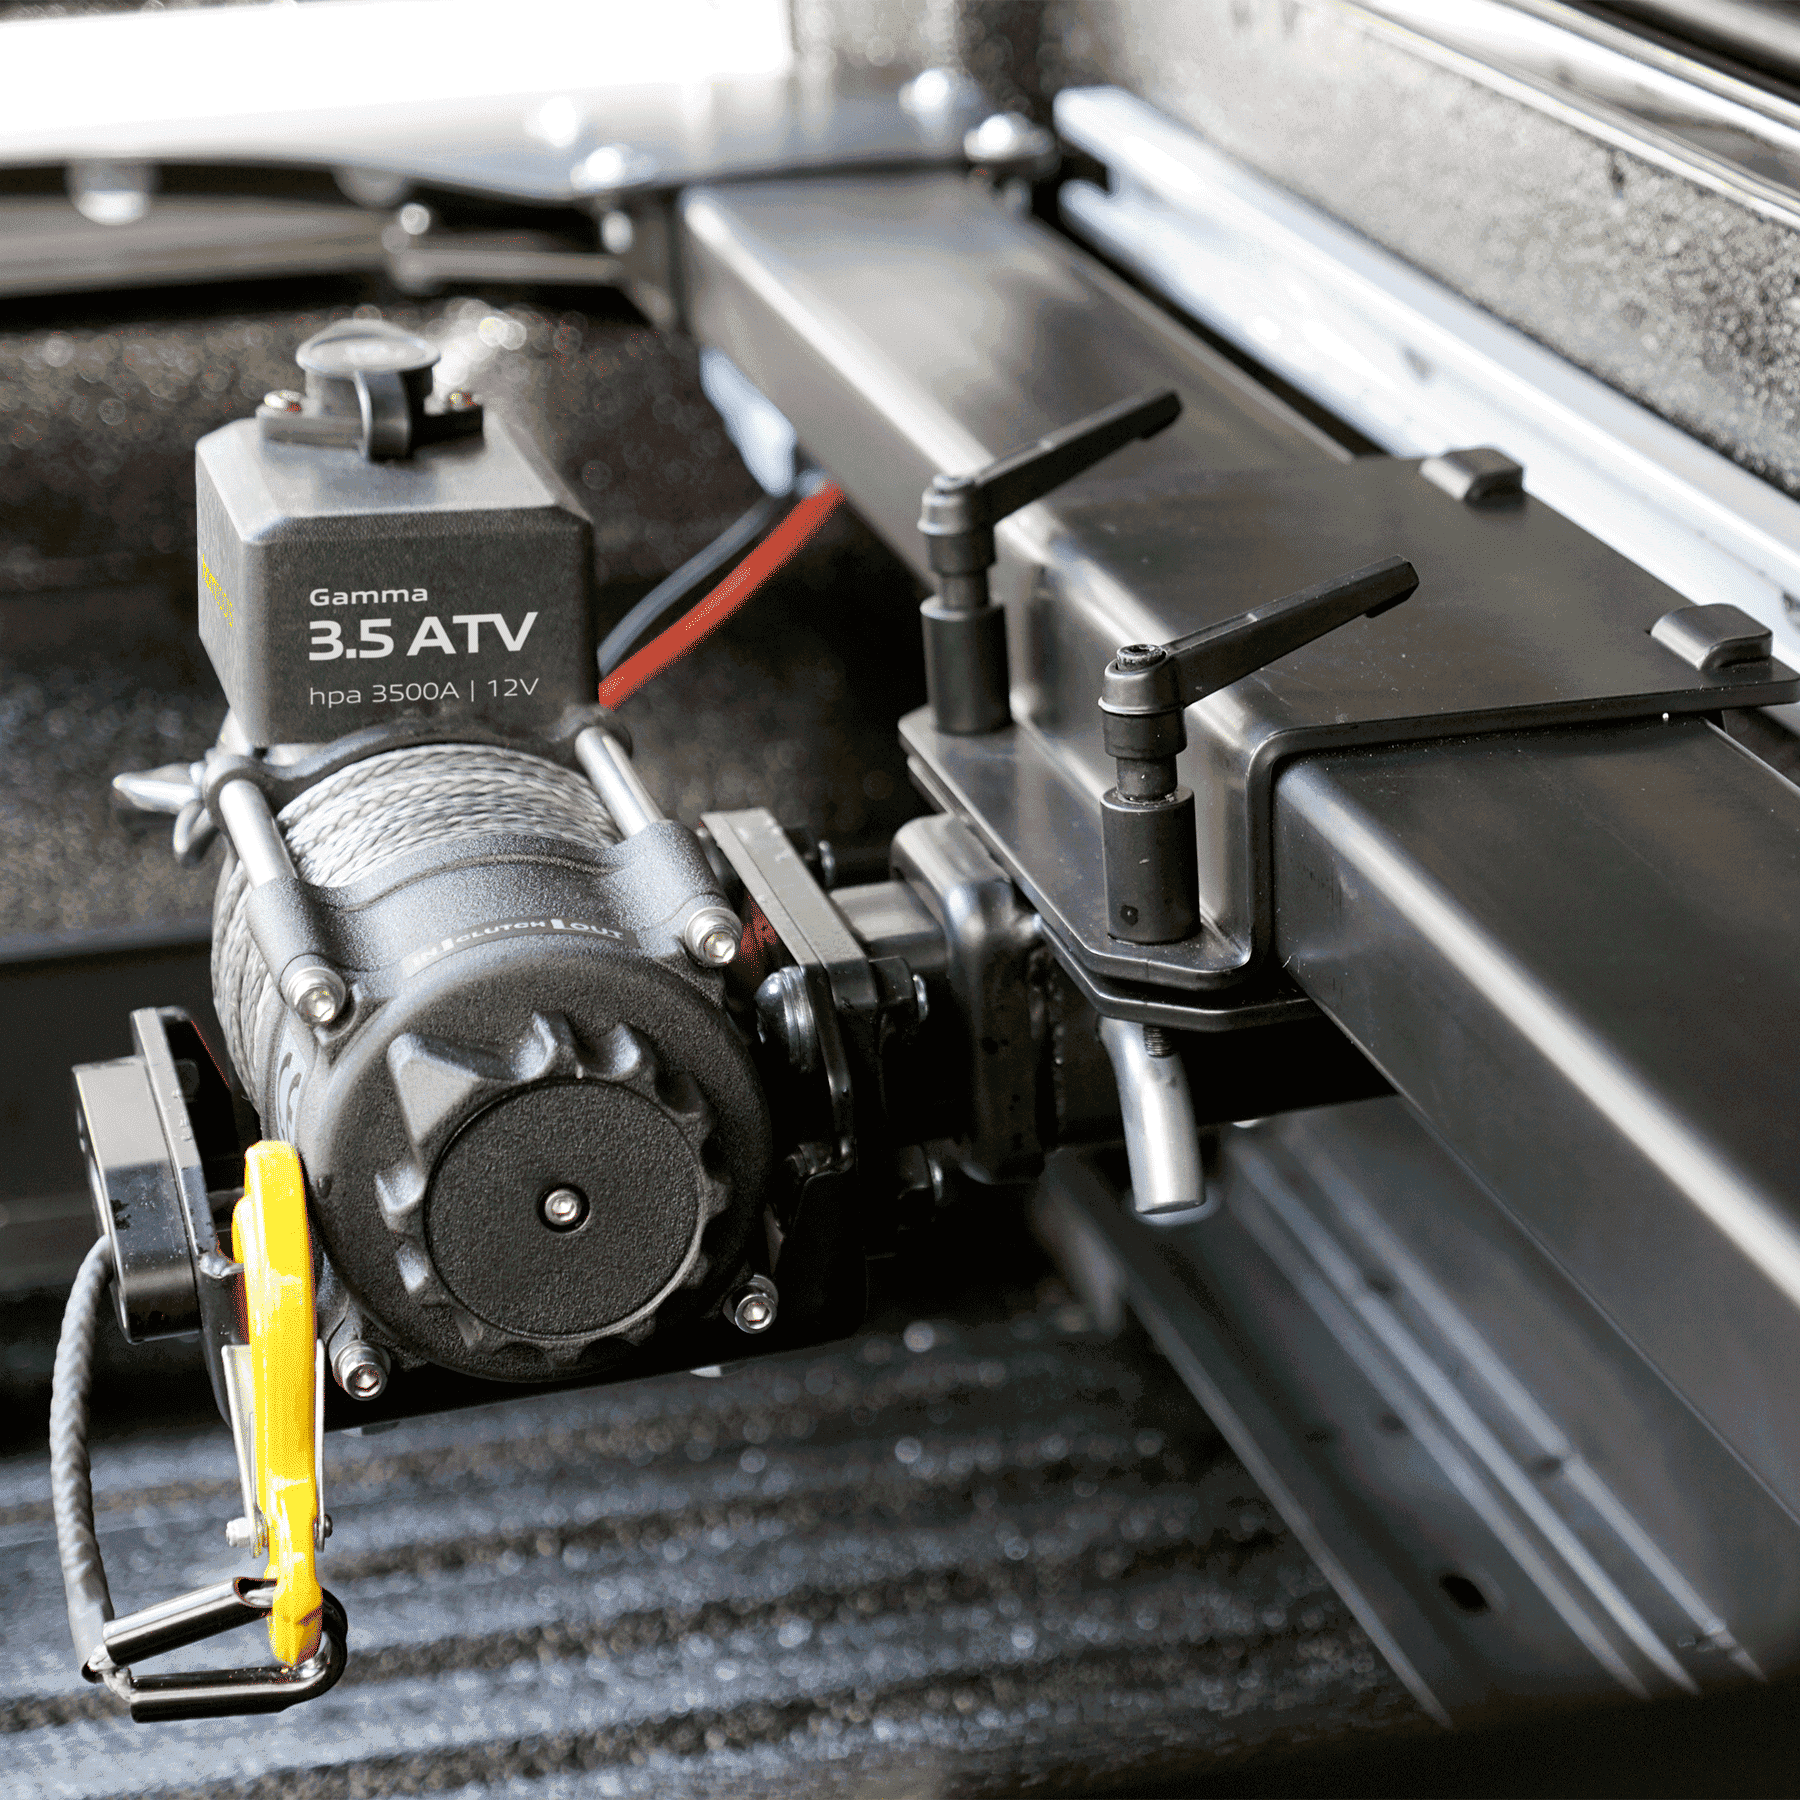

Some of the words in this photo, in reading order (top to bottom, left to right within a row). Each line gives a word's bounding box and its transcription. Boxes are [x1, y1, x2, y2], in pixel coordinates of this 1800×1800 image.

[309, 588, 428, 606] Gamma
[309, 618, 394, 660] 3.5
[406, 611, 538, 656] ATV
[309, 687, 361, 708] hpa
[372, 681, 460, 703] 3500A
[487, 677, 539, 697] 12V
[456, 921, 546, 943] CLUTCH
[570, 922, 623, 940] OUT
